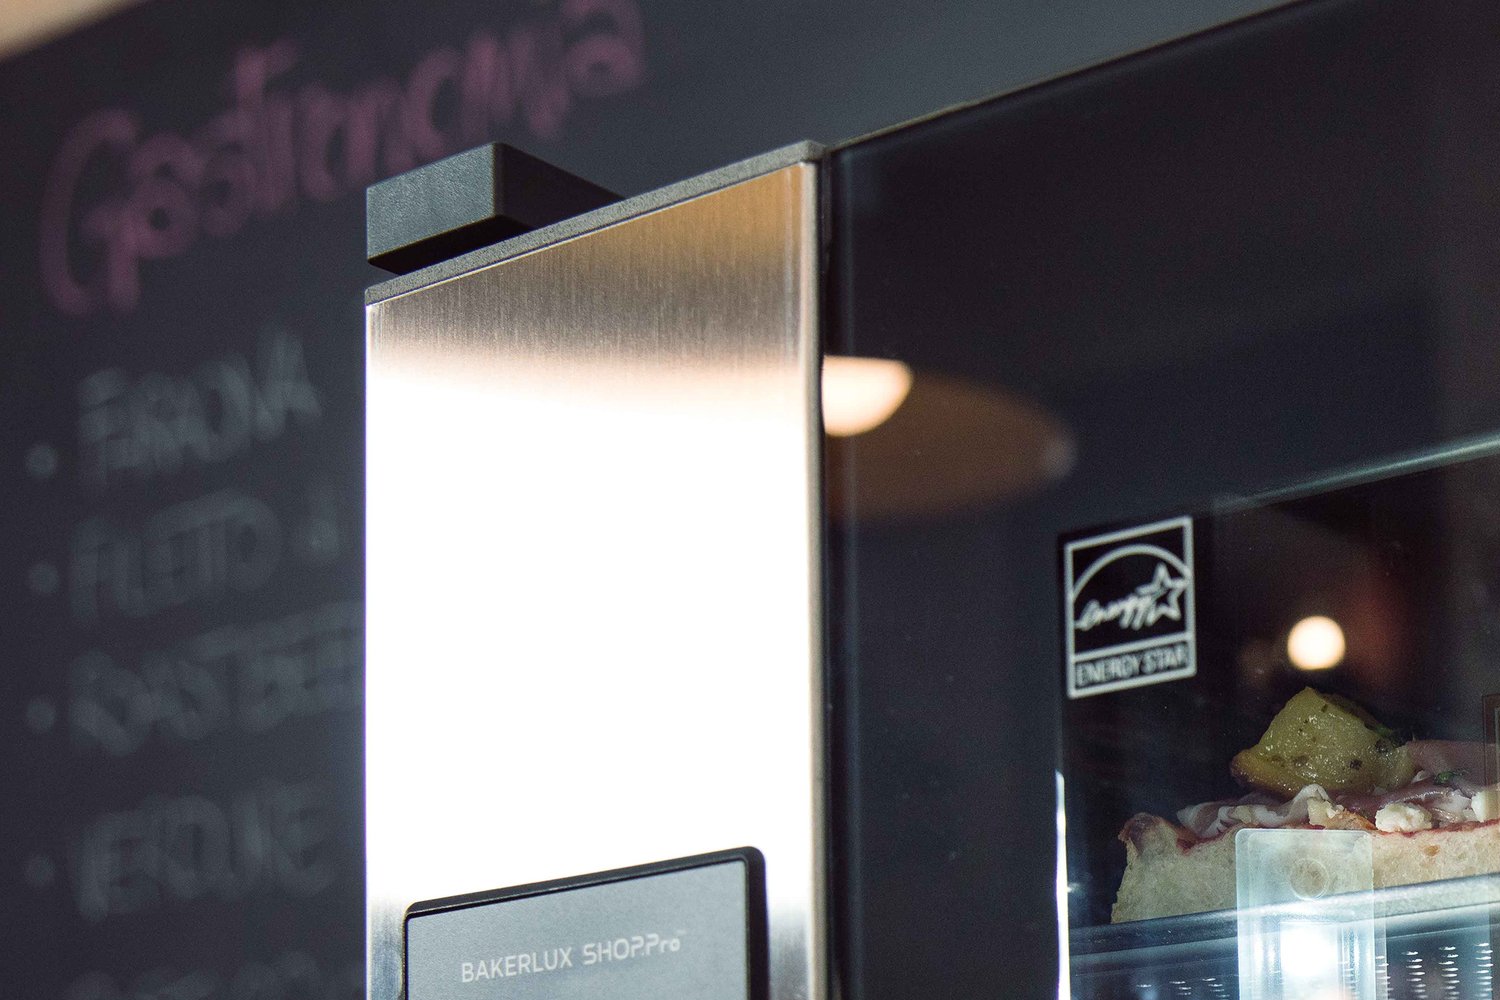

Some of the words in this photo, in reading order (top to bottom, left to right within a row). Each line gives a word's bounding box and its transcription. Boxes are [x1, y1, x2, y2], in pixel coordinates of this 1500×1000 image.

[1075, 654, 1142, 687] ENERGY
[1140, 642, 1188, 675] STAR
[461, 946, 573, 984] BAKERLUX
